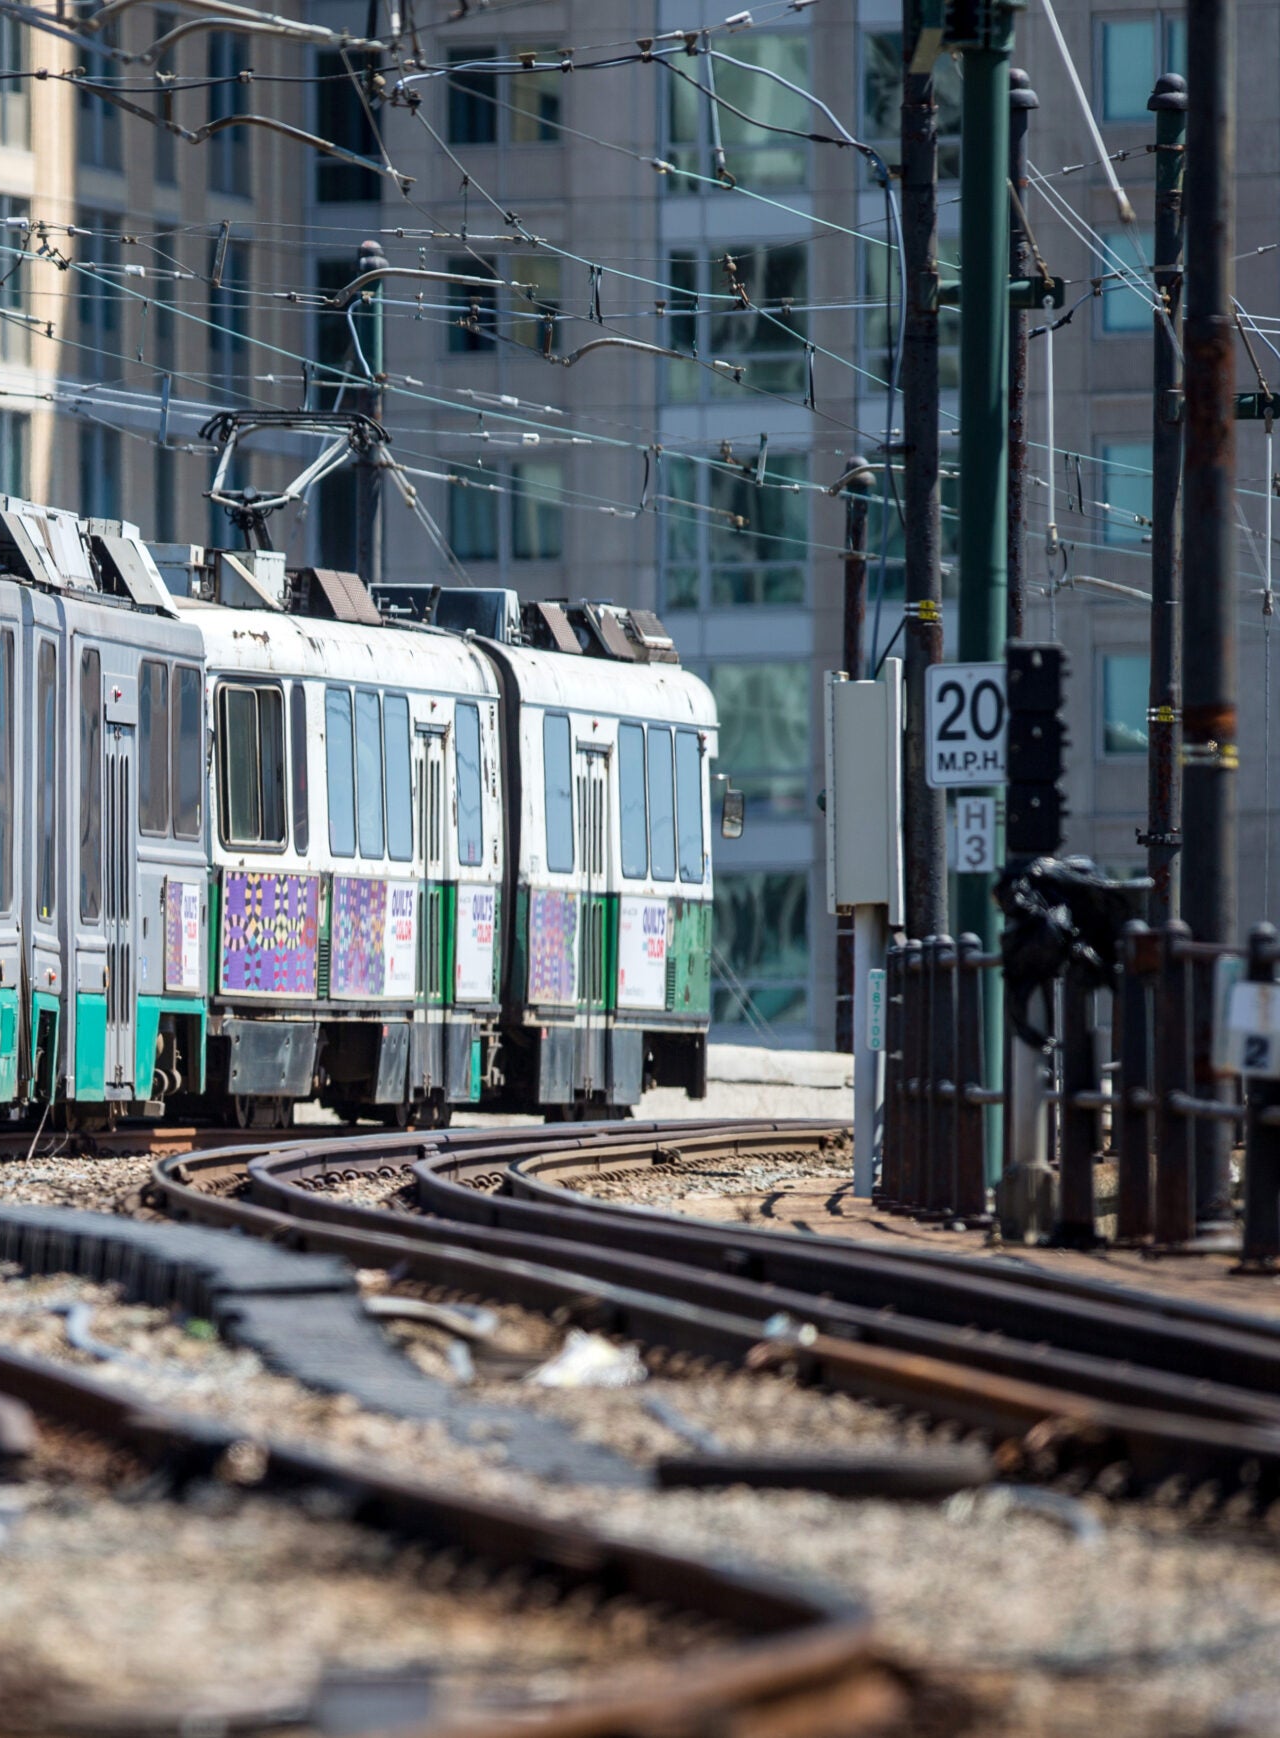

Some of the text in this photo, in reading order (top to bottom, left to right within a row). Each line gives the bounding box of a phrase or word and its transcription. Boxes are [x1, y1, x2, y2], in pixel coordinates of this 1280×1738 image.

[936, 679, 1004, 741] 20
[937, 751, 1006, 771] M.P.H.
[965, 804, 987, 829] H
[965, 834, 987, 866] 3
[643, 906, 665, 935] QUILTS
